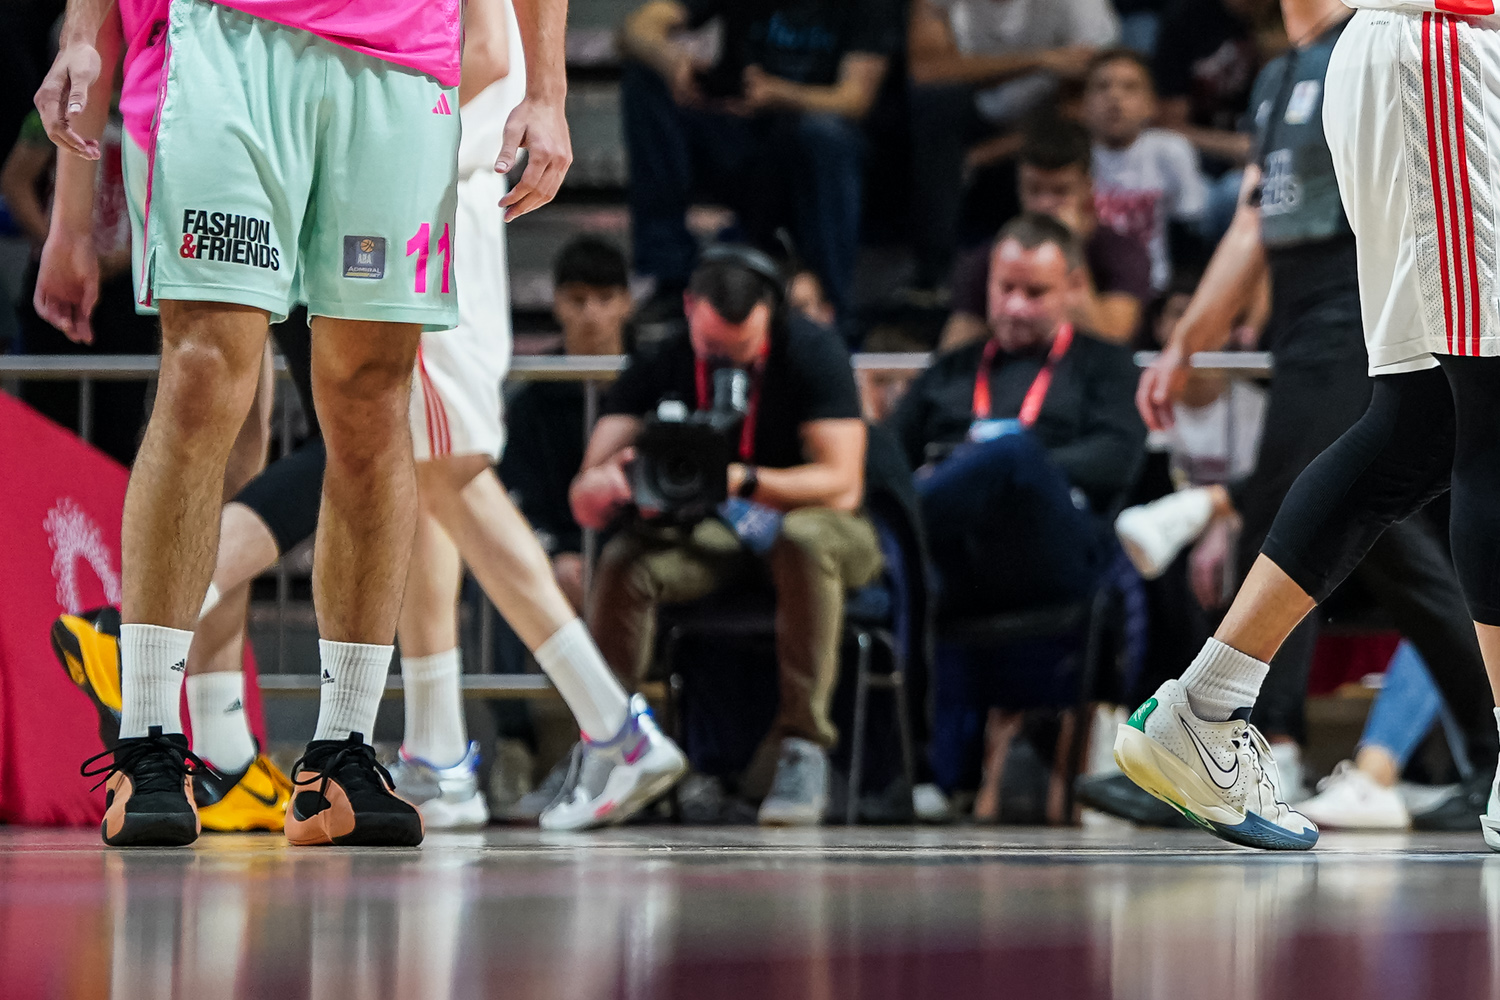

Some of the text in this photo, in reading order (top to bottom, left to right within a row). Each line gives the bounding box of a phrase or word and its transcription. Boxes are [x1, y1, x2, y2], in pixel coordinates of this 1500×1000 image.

[182, 209, 270, 245] FASHION
[179, 233, 280, 271] &FRIENDS
[406, 222, 450, 293] 11
